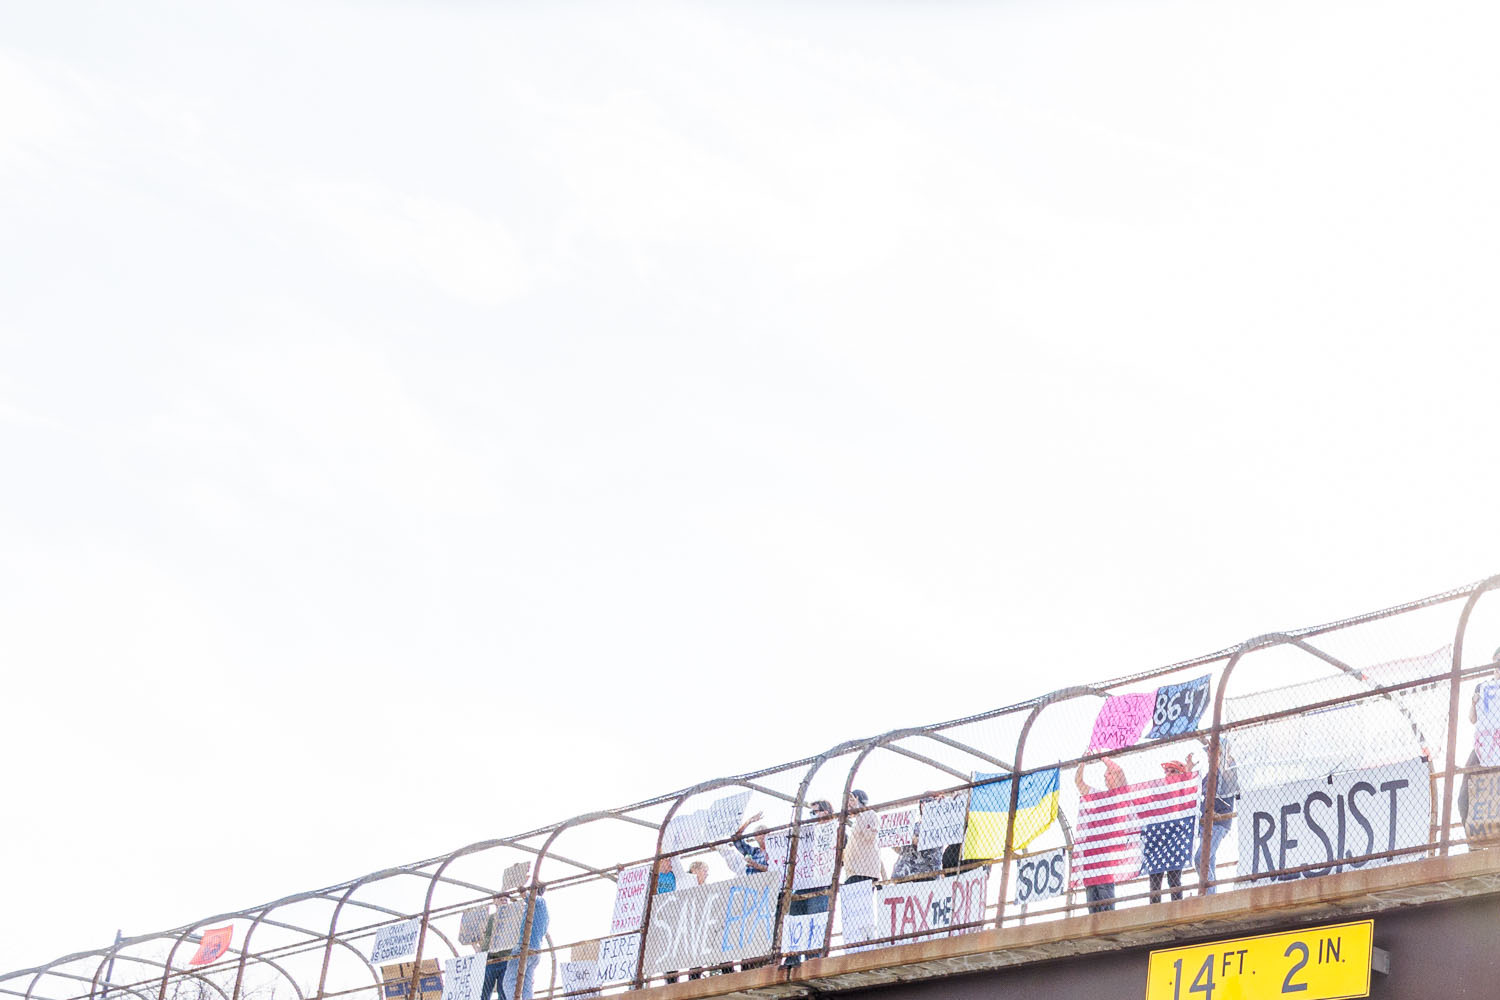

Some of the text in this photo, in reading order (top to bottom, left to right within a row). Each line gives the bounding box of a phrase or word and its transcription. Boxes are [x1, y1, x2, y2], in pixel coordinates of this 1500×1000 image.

[1253, 780, 1409, 881] RESIST
[1018, 854, 1064, 901] SOS
[654, 892, 720, 967] SAVE
[721, 885, 772, 953] EPA
[884, 891, 934, 945] TAX
[931, 896, 952, 926] THE
[951, 876, 989, 936] RICH
[380, 942, 415, 959] CORRUPT
[455, 956, 476, 974] EAT
[597, 960, 637, 981] MUSK
[602, 935, 636, 960] FIRE
[1281, 941, 1310, 995] 2
